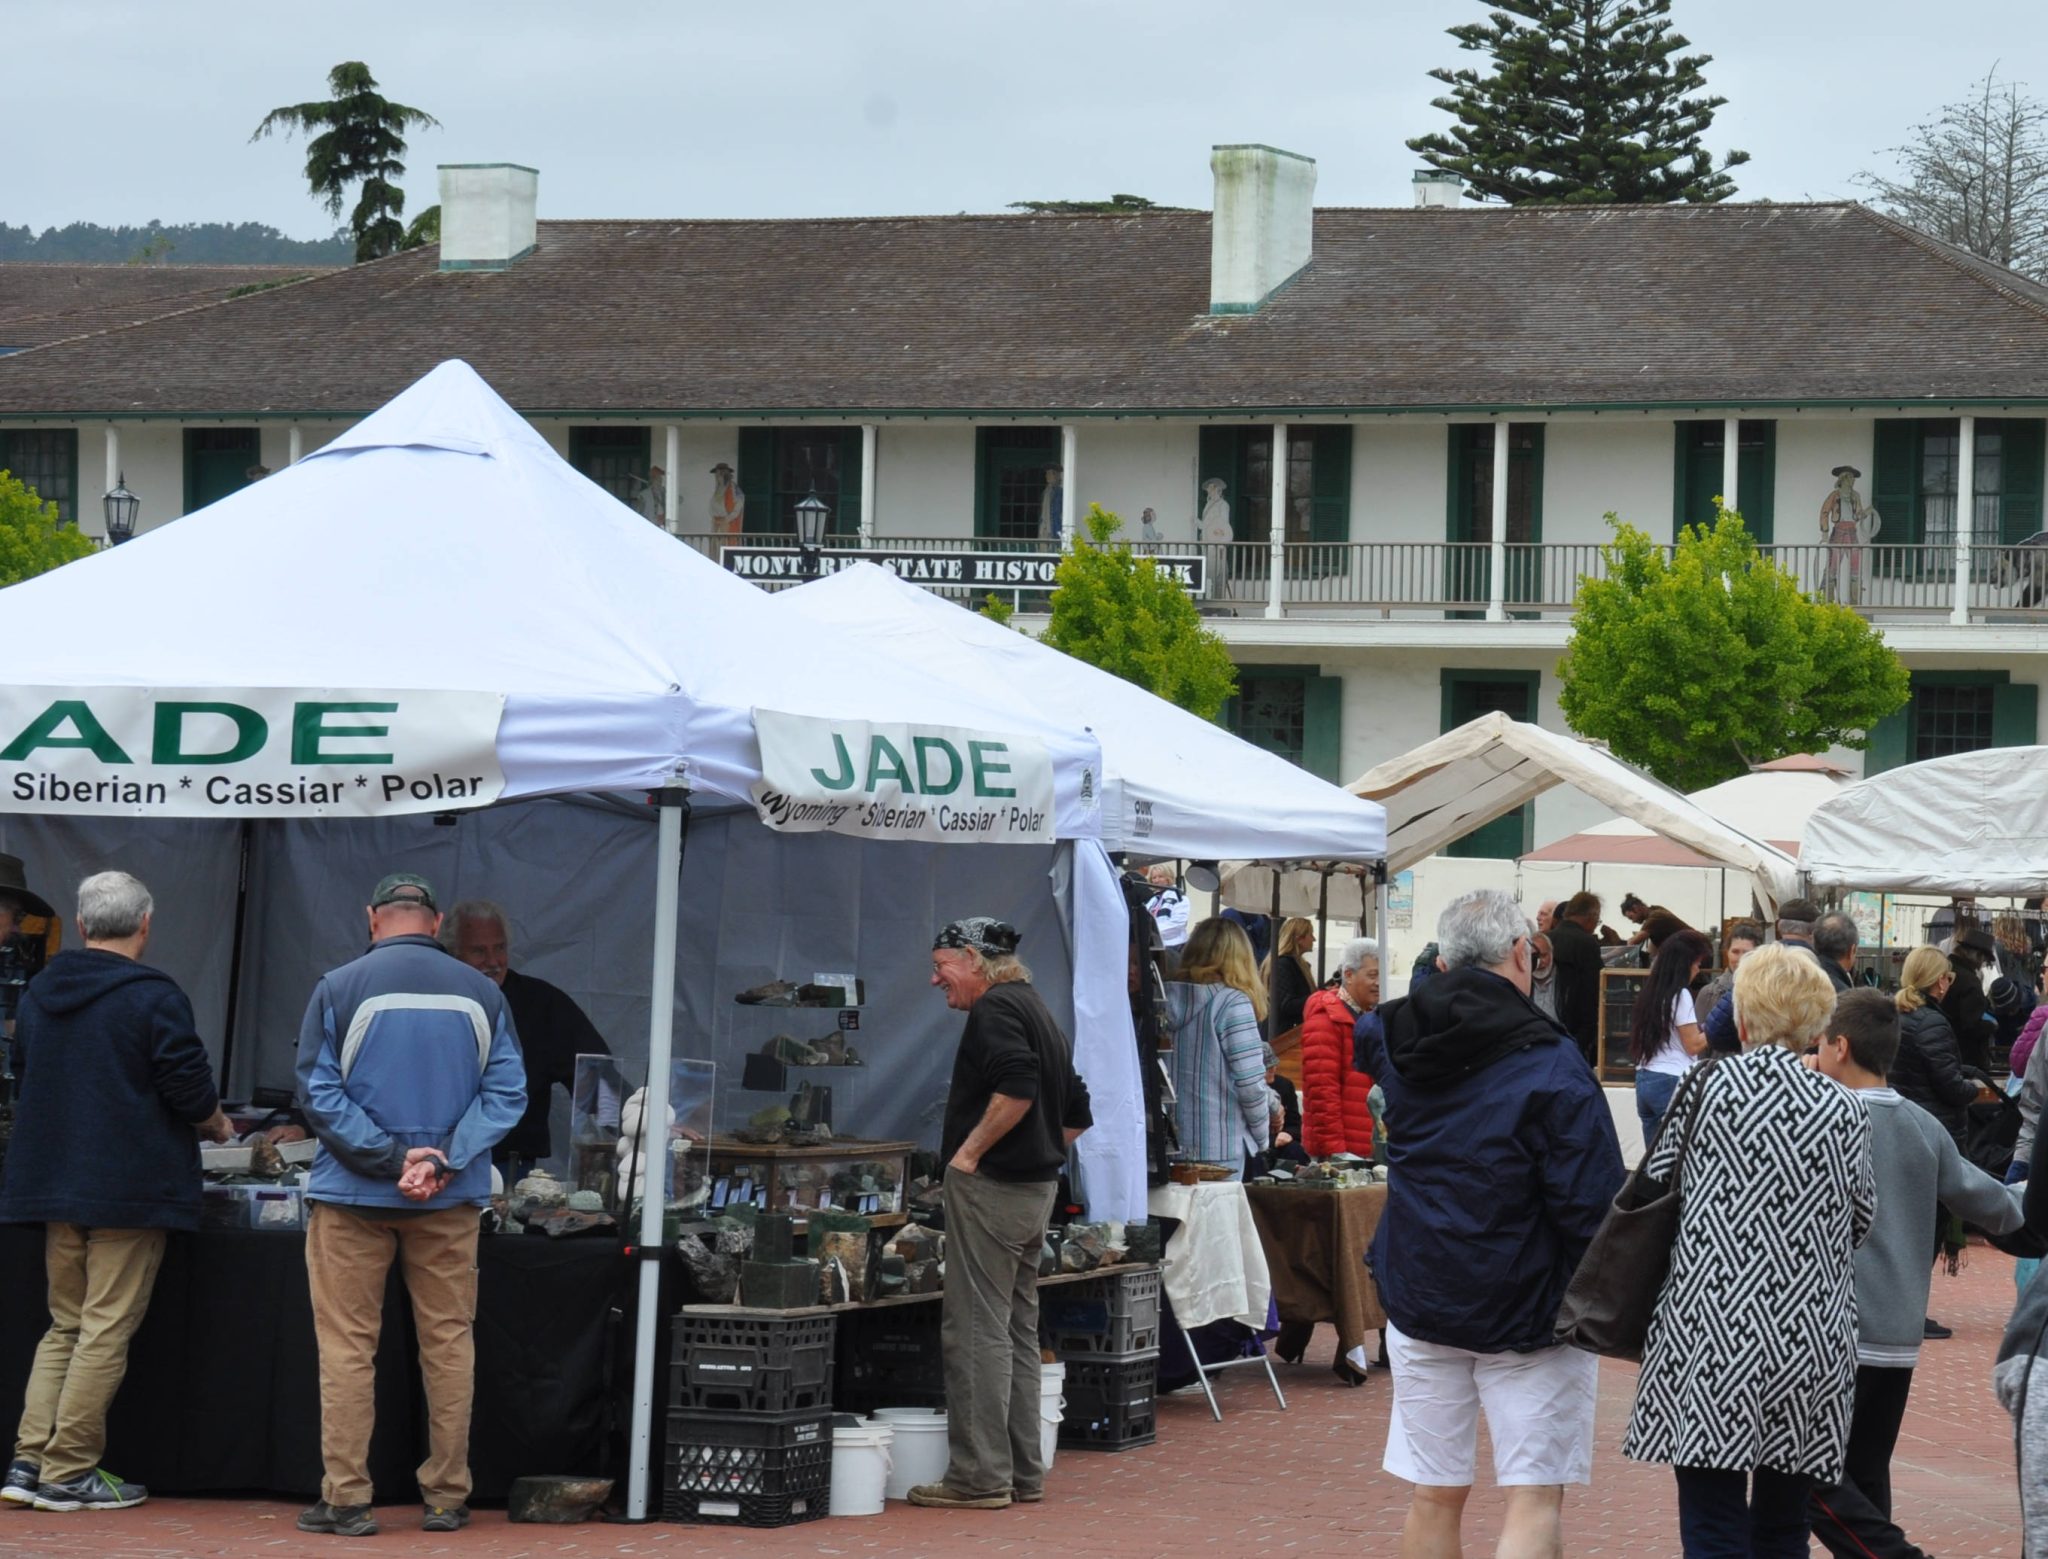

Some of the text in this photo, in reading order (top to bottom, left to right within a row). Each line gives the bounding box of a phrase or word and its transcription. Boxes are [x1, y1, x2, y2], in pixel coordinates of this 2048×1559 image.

[733, 555, 871, 576] MONTRE
[881, 557, 963, 581] STATE
[974, 560, 1084, 582] HISTO
[810, 733, 1016, 798] JADE
[12, 772, 483, 804] Siberian Cassiar Polar
[761, 791, 1045, 831] Wyoming Siberian Cassiar Polar
